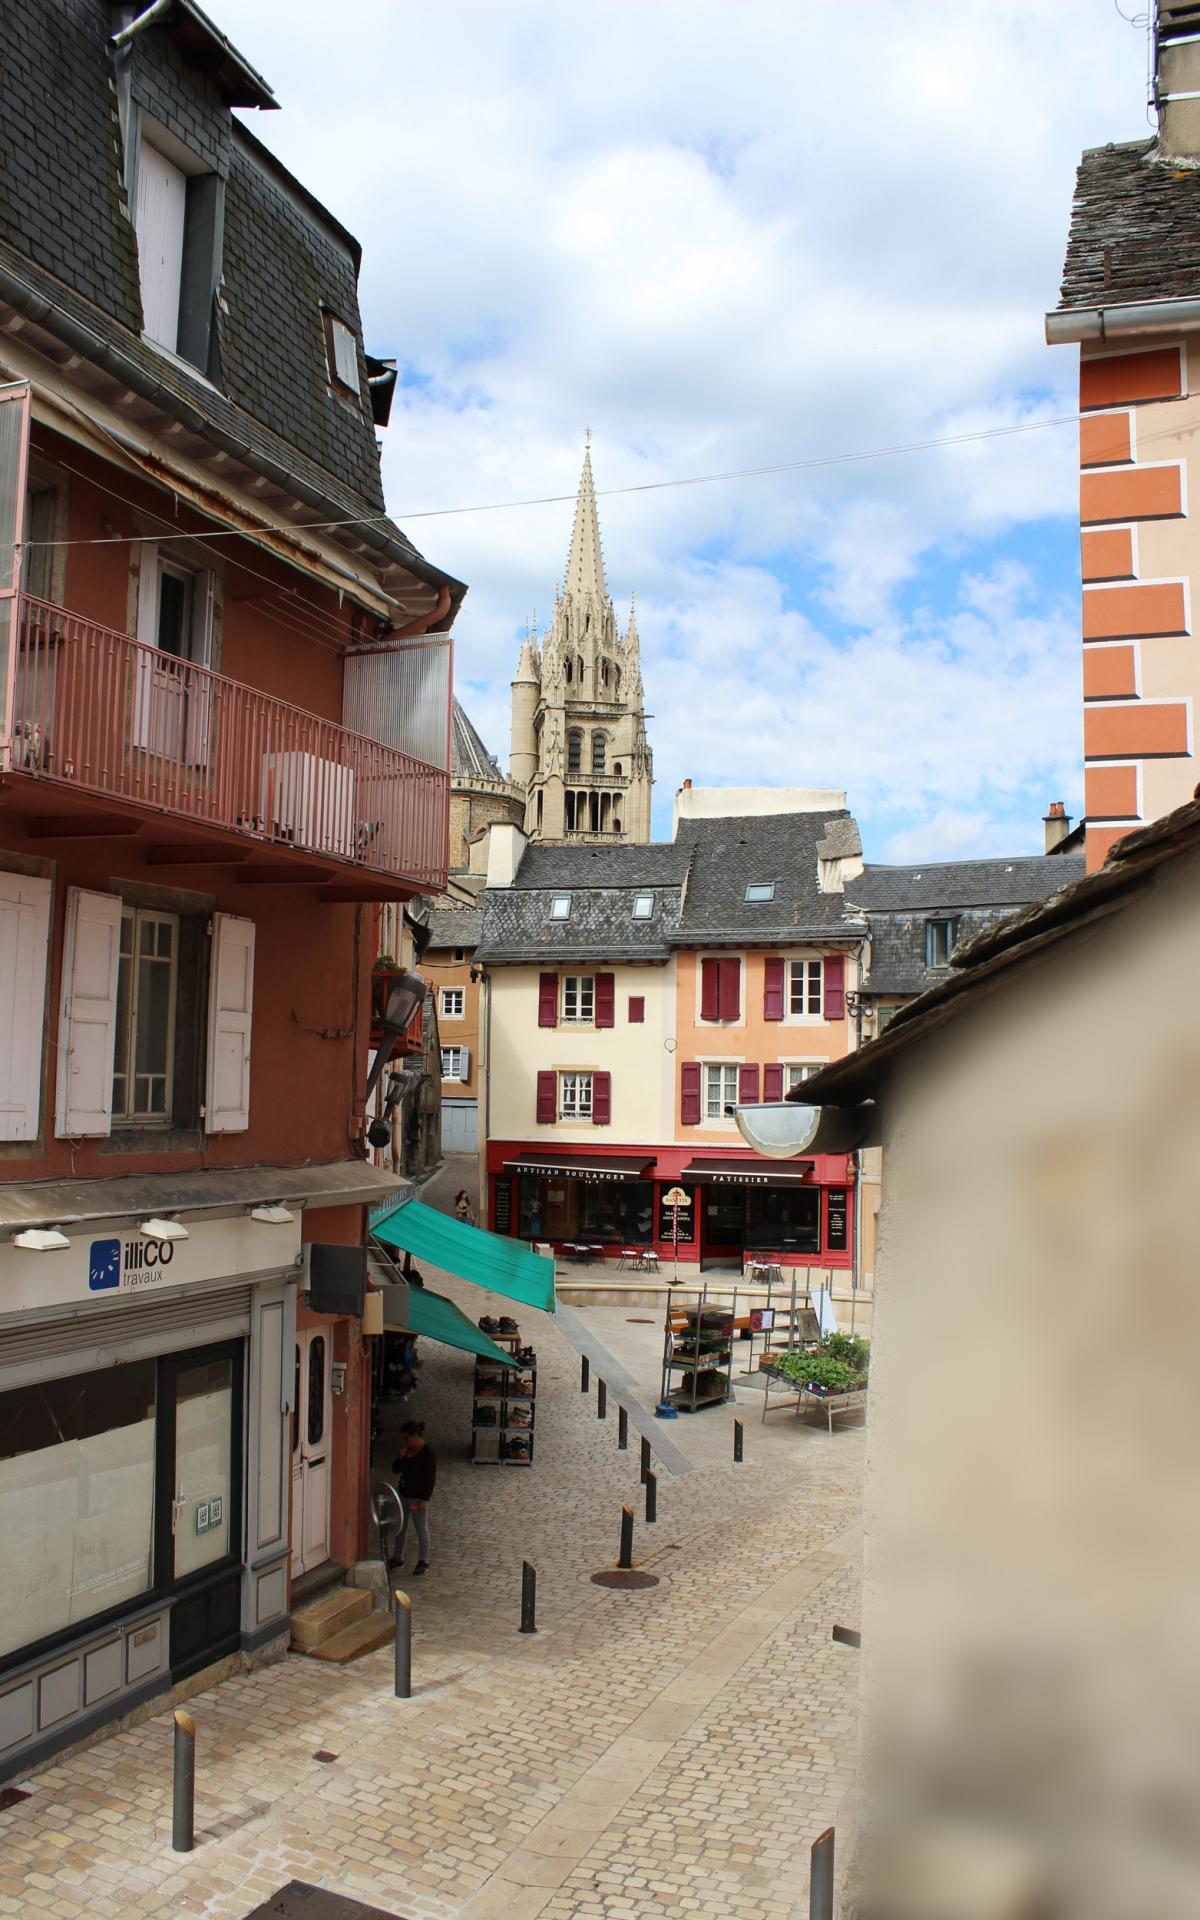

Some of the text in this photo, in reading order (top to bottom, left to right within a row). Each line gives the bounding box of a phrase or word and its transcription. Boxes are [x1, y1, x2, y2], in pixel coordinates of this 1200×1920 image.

[516, 1166, 625, 1180] ARTISAN BOULANGER
[712, 1175, 769, 1183] PATISSIER
[123, 1270, 163, 1286] travaux
